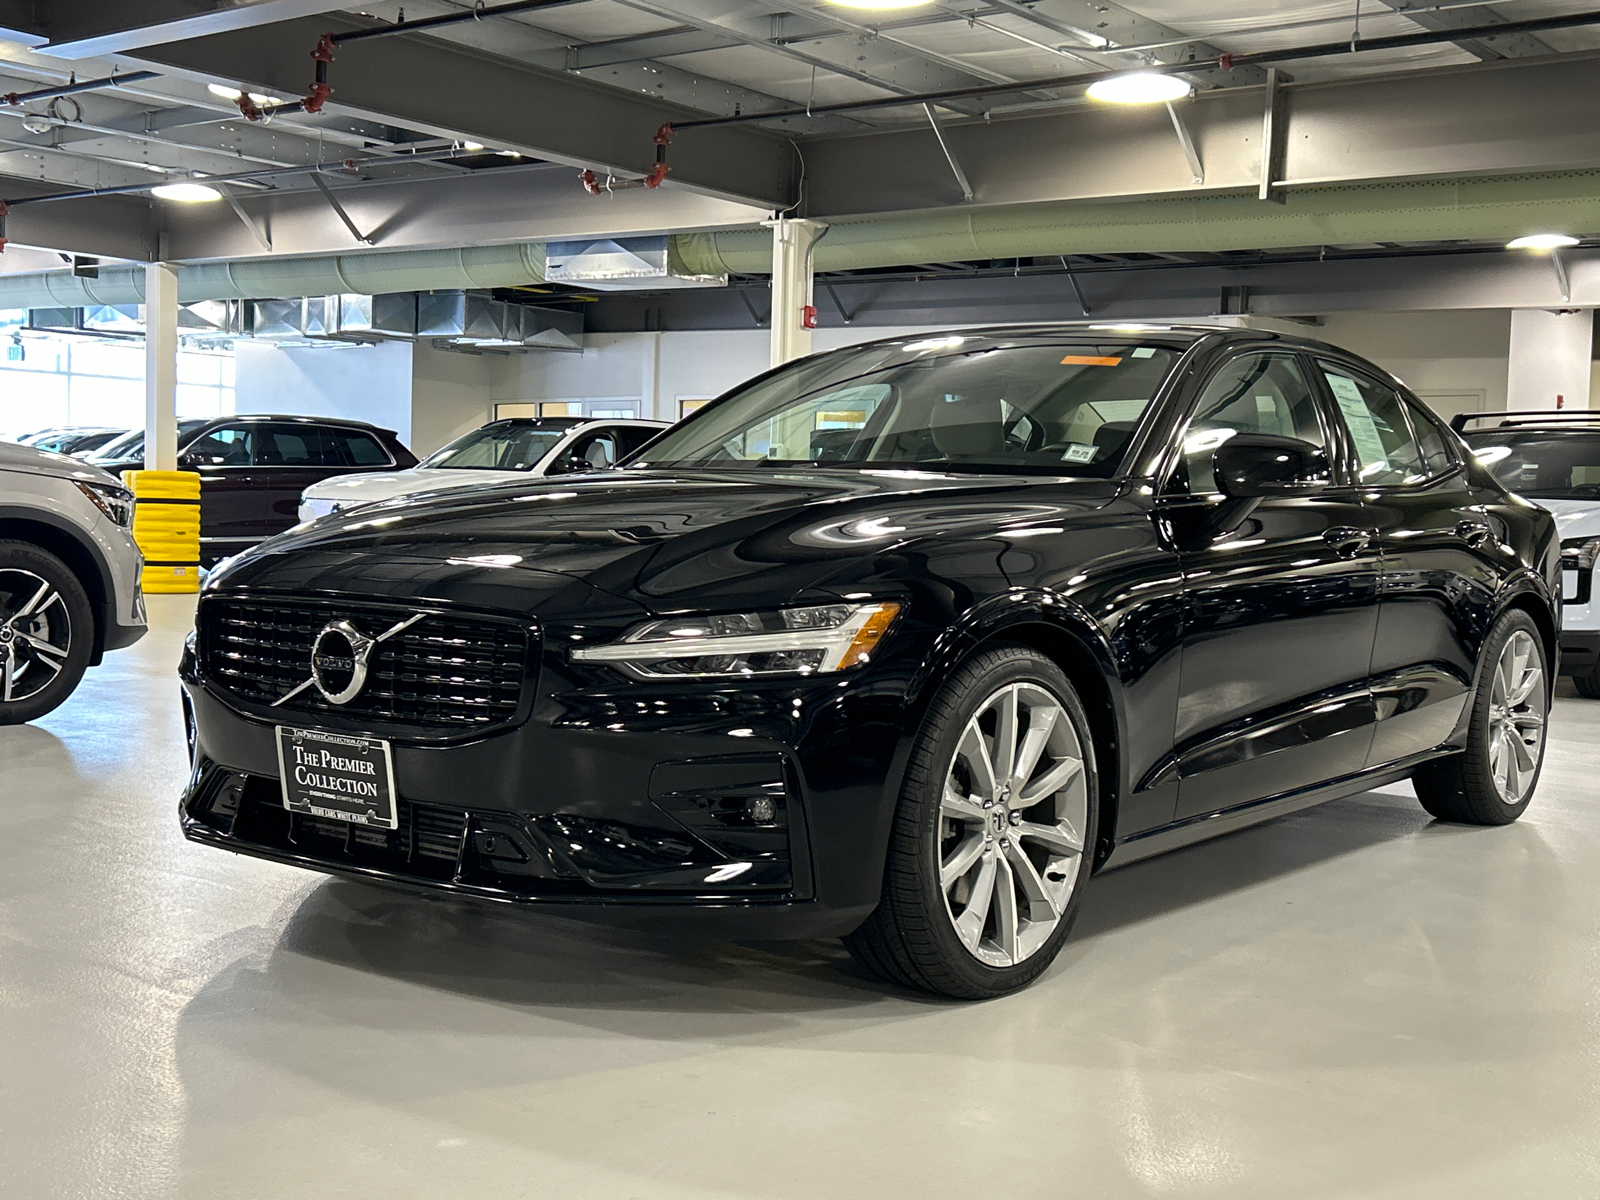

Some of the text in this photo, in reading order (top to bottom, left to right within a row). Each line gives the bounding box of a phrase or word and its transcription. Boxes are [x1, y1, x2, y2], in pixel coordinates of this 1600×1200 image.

[314, 656, 353, 669] VOLVO
[292, 745, 376, 776] THE PREMIER
[294, 765, 378, 797] COLLECTION
